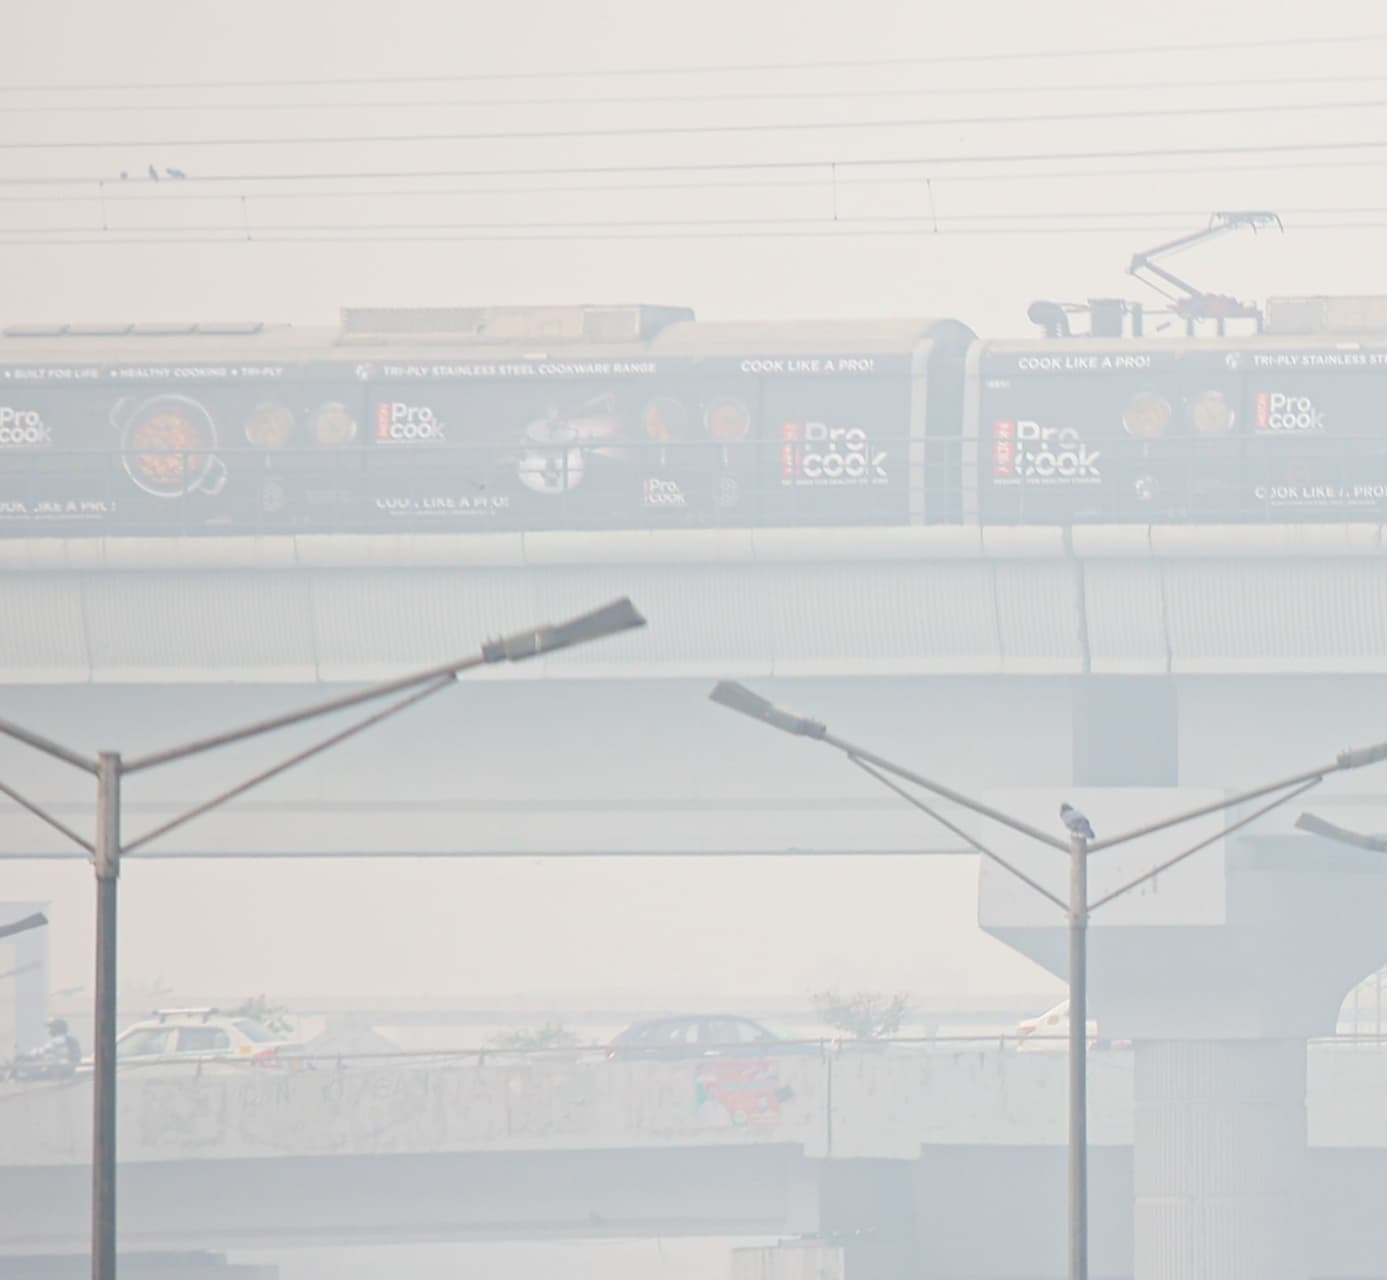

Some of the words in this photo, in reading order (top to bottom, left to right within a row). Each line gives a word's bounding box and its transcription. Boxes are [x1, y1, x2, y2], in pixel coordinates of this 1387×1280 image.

[383, 364, 428, 376] TRI-PLY
[432, 364, 496, 375] STAINLESS
[499, 363, 536, 374] STEEL
[539, 362, 610, 374] COOKWARE
[613, 362, 656, 373] RANGE
[740, 360, 785, 373] COOK
[787, 359, 820, 372] LIKE
[824, 359, 835, 371] A
[838, 358, 874, 371] PRO!
[1018, 357, 1062, 370] COOK
[1065, 357, 1097, 369] LIKE
[1101, 356, 1112, 368] A
[1115, 355, 1151, 368] PRO!
[1253, 354, 1298, 366] TRI-PLY
[1302, 353, 1365, 365] STAINLESS
[14, 368, 47, 378] BUILT
[48, 368, 67, 378] FOR
[69, 367, 98, 378] LIFE
[119, 367, 170, 378] HEALTHY
[173, 366, 226, 377] COOKING
[241, 366, 283, 377] TRI-PLY
[391, 402, 433, 422] Pro
[1270, 392, 1311, 412] Pro
[0, 407, 39, 426] Pro
[1268, 407, 1327, 429] cook
[0, 420, 52, 443] cook
[390, 417, 446, 439] cook
[804, 421, 867, 450] Pro
[1017, 420, 1080, 450] Pro
[802, 446, 888, 478] cook
[1254, 486, 1299, 498] COK
